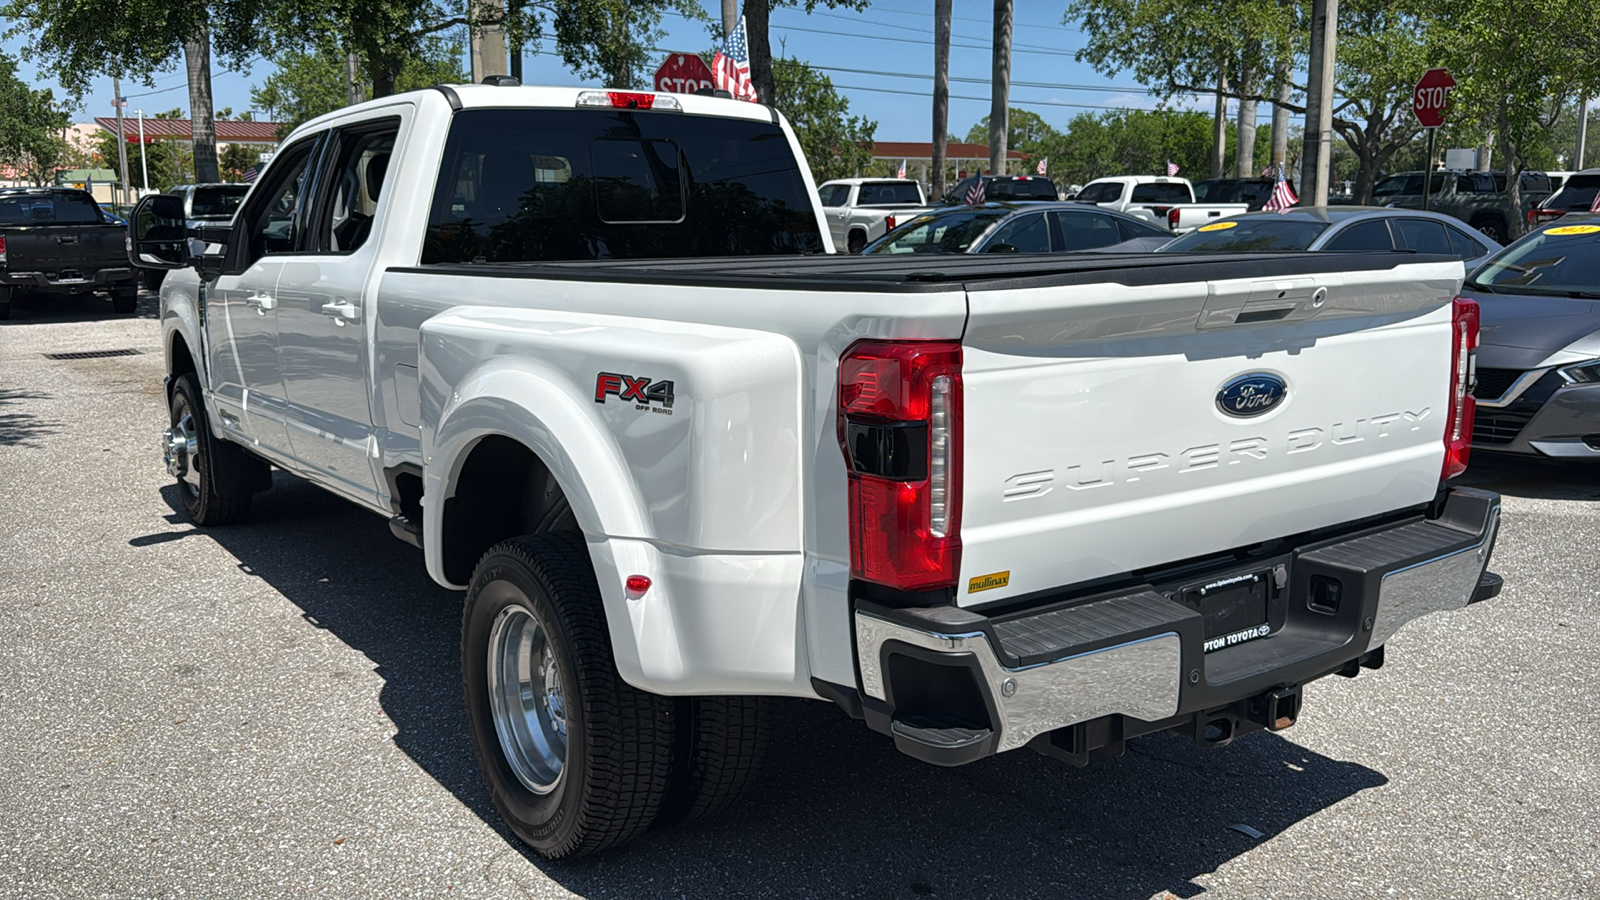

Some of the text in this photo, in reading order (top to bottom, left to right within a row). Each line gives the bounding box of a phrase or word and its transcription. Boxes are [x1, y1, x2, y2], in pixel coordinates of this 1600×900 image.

[595, 372, 675, 408] FX4
[1235, 383, 1275, 410] Ford
[635, 404, 673, 416] OFF ROAD
[1003, 406, 1431, 503] SUPER DUTY
[970, 576, 1008, 591] mullinax
[1203, 628, 1259, 653] PTON TOYOTA
